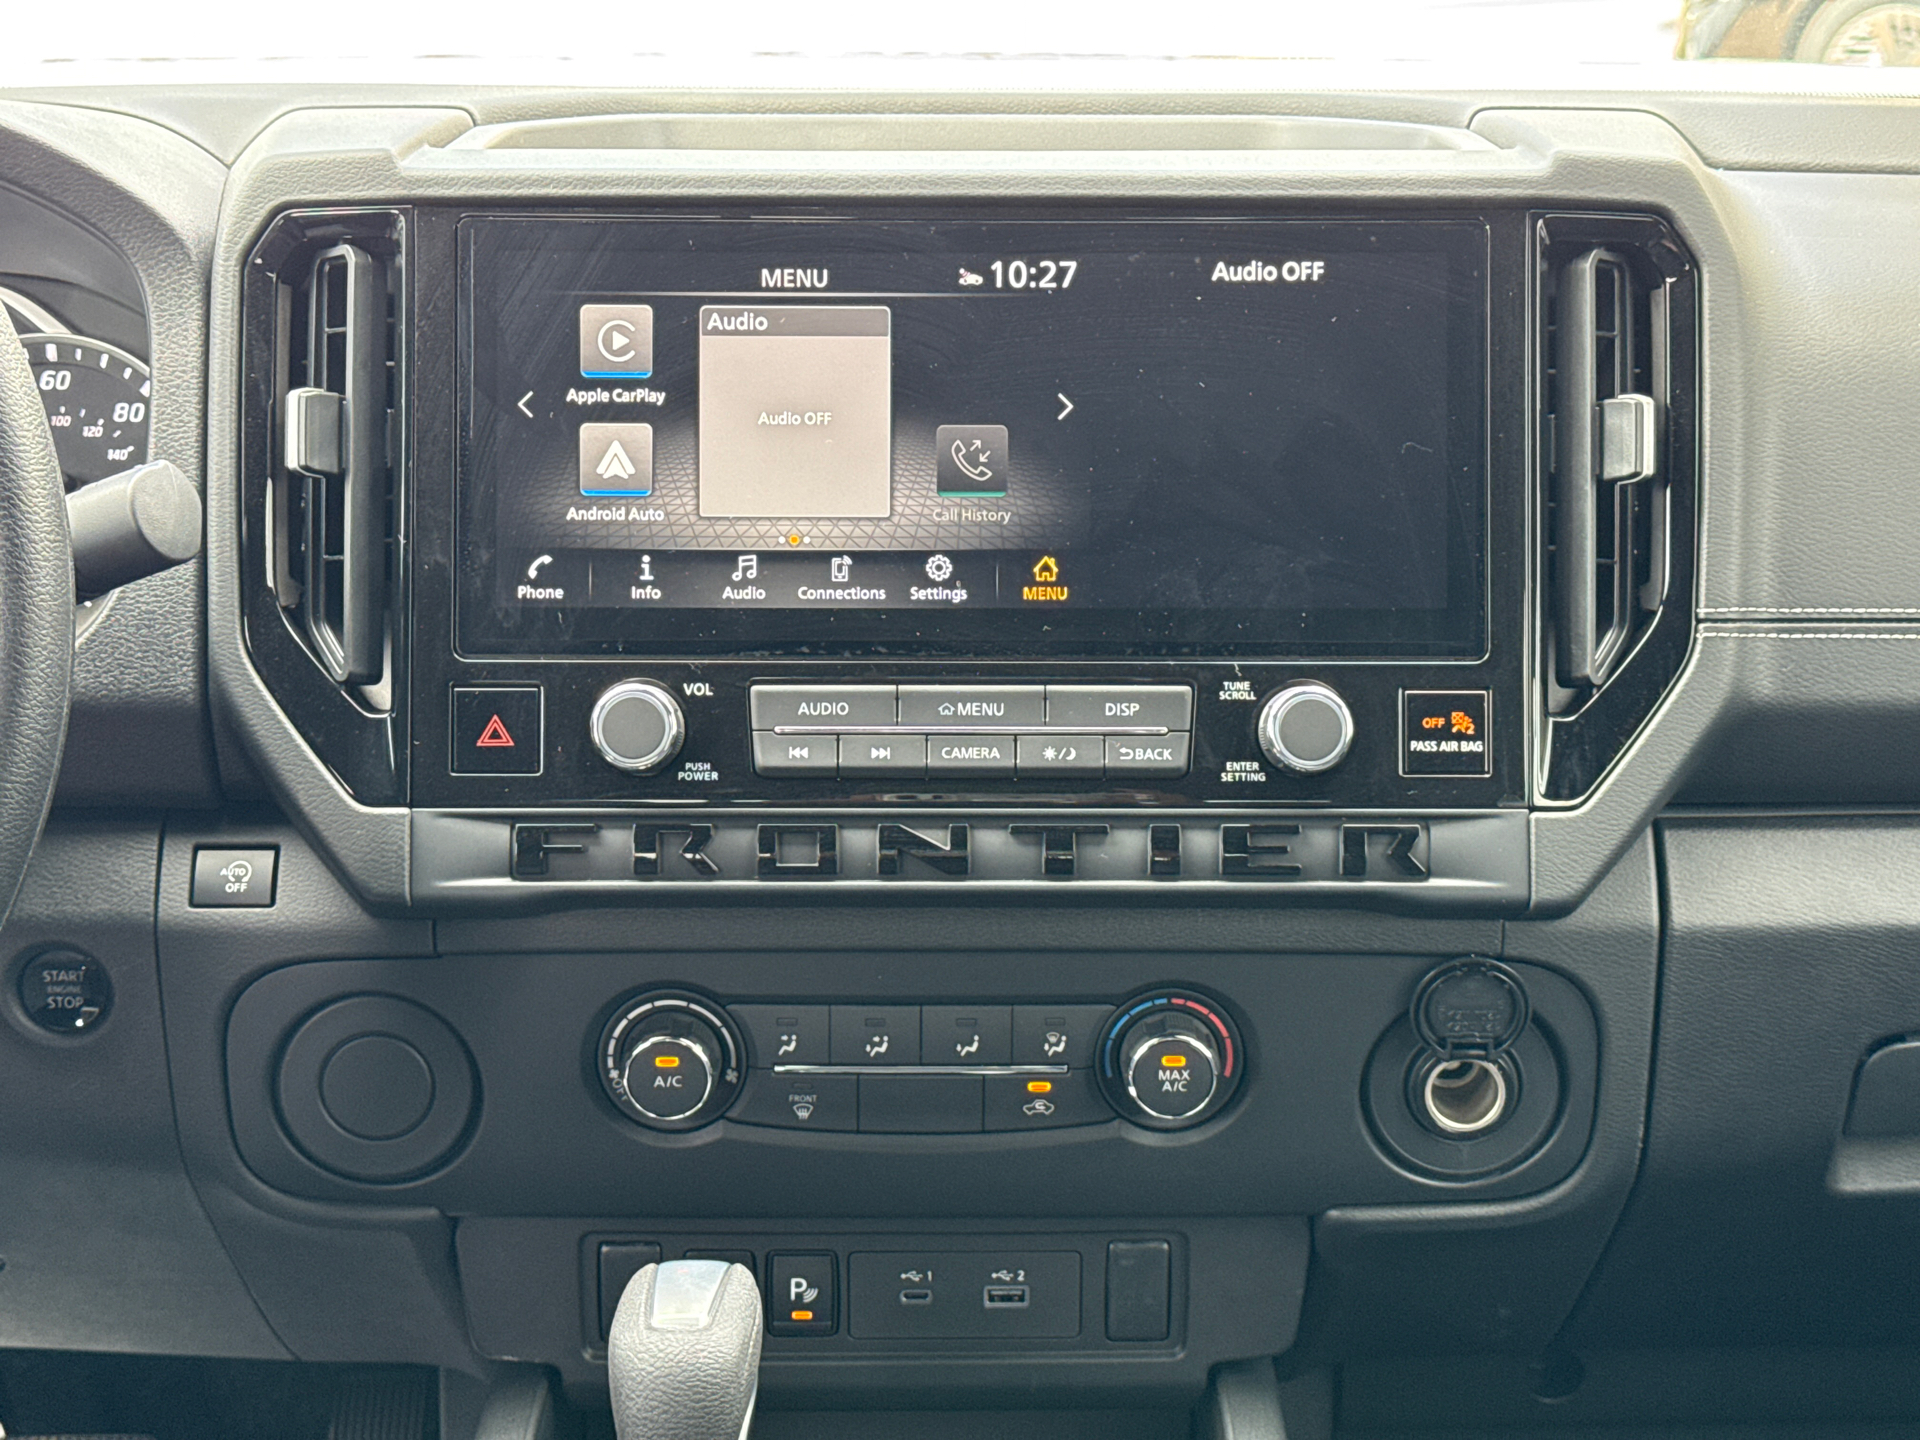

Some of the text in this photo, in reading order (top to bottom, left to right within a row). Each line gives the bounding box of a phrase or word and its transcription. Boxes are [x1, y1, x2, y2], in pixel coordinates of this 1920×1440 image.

[760, 268, 829, 288] MENU
[990, 260, 1078, 289] 10:27
[1211, 261, 1325, 282] Audio OFF
[707, 311, 769, 331] Audio
[39, 370, 71, 391] 60
[566, 388, 666, 406] Apple CarPlay
[112, 402, 146, 423] 80
[757, 411, 833, 426] Audio OFF
[51, 415, 72, 427] 100
[82, 426, 104, 438] 120
[566, 506, 665, 521] Android Auto
[932, 508, 1012, 525] Call History
[517, 585, 564, 600] Phone
[631, 586, 662, 600] Info
[722, 585, 766, 600] Audio
[797, 586, 887, 601] Connections
[909, 586, 968, 603] Settings
[1022, 586, 1068, 601] MENU
[683, 683, 714, 697] VOL
[1223, 681, 1251, 691] TUNE
[1219, 690, 1257, 700] SCROLL
[797, 702, 850, 717] AUDIO
[957, 703, 1005, 717] MENU
[1104, 702, 1141, 717] DISP
[1421, 717, 1446, 729] OFF
[1410, 740, 1484, 752] PASS AIR BAG
[941, 747, 1001, 760] CAMERA
[1135, 748, 1173, 761] BACK
[685, 762, 711, 771] PUSH
[1226, 762, 1260, 772] ENTER
[678, 771, 719, 782] POWER
[1220, 772, 1267, 782] SETTING
[513, 823, 1428, 876] FRONTIER
[225, 882, 248, 893] OFF
[42, 969, 85, 983] START
[46, 995, 84, 1009] STOP
[653, 1075, 683, 1088] A/C
[1158, 1069, 1191, 1081] MAX
[1161, 1081, 1188, 1092] A/C
[789, 1095, 817, 1103] FRONT
[927, 1270, 933, 1281] 1
[1016, 1270, 1025, 1282] 2
[790, 1277, 807, 1302] P
